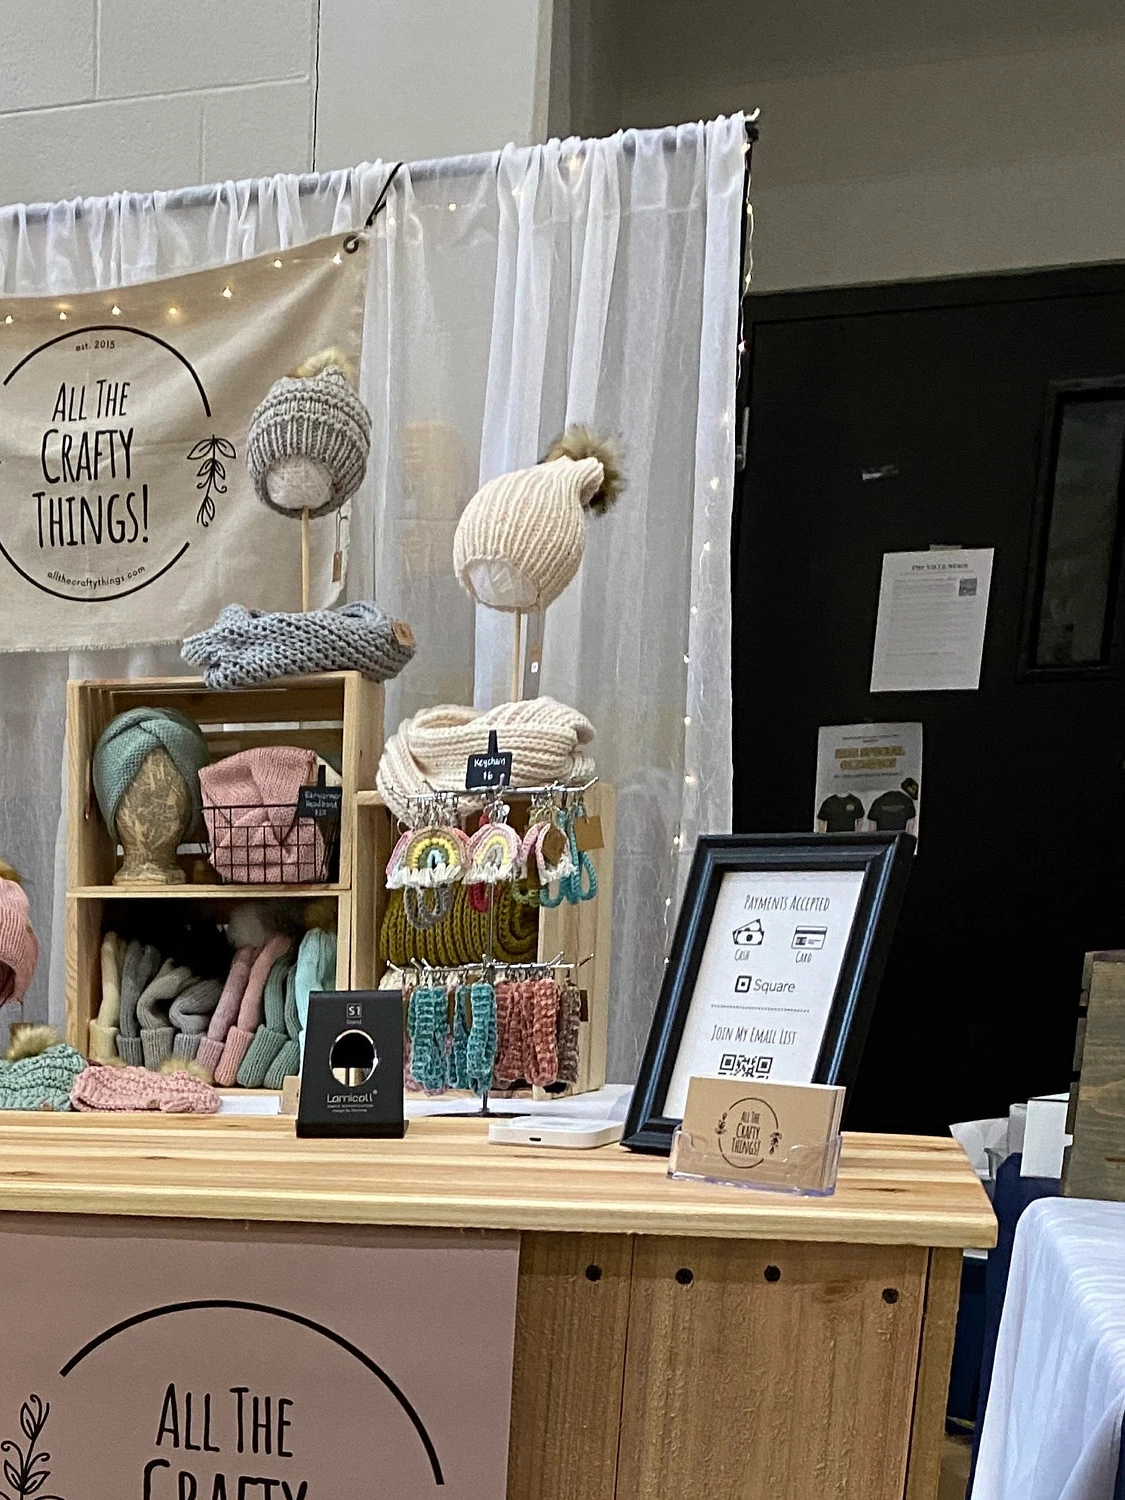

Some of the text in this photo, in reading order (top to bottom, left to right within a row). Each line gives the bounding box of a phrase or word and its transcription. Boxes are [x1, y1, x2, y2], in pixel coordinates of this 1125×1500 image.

[94, 340, 116, 349] 2015
[51, 379, 131, 422] ALL THE
[41, 427, 134, 483] CRAFTY
[32, 484, 149, 548] THINGS!
[47, 566, 145, 589] allthecraftythings.com
[744, 894, 830, 912] PAYMENTS ACCEPTED
[795, 951, 812, 963] CARD
[753, 979, 795, 993] Square
[348, 1006, 361, 1016] S1
[711, 1024, 797, 1045] JOIN MY EMAIL LIST
[741, 1111, 750, 1123] ALL
[736, 1123, 761, 1140] CRAFTY
[731, 1137, 761, 1156] THINGS!
[156, 1383, 294, 1457] ALL THE
